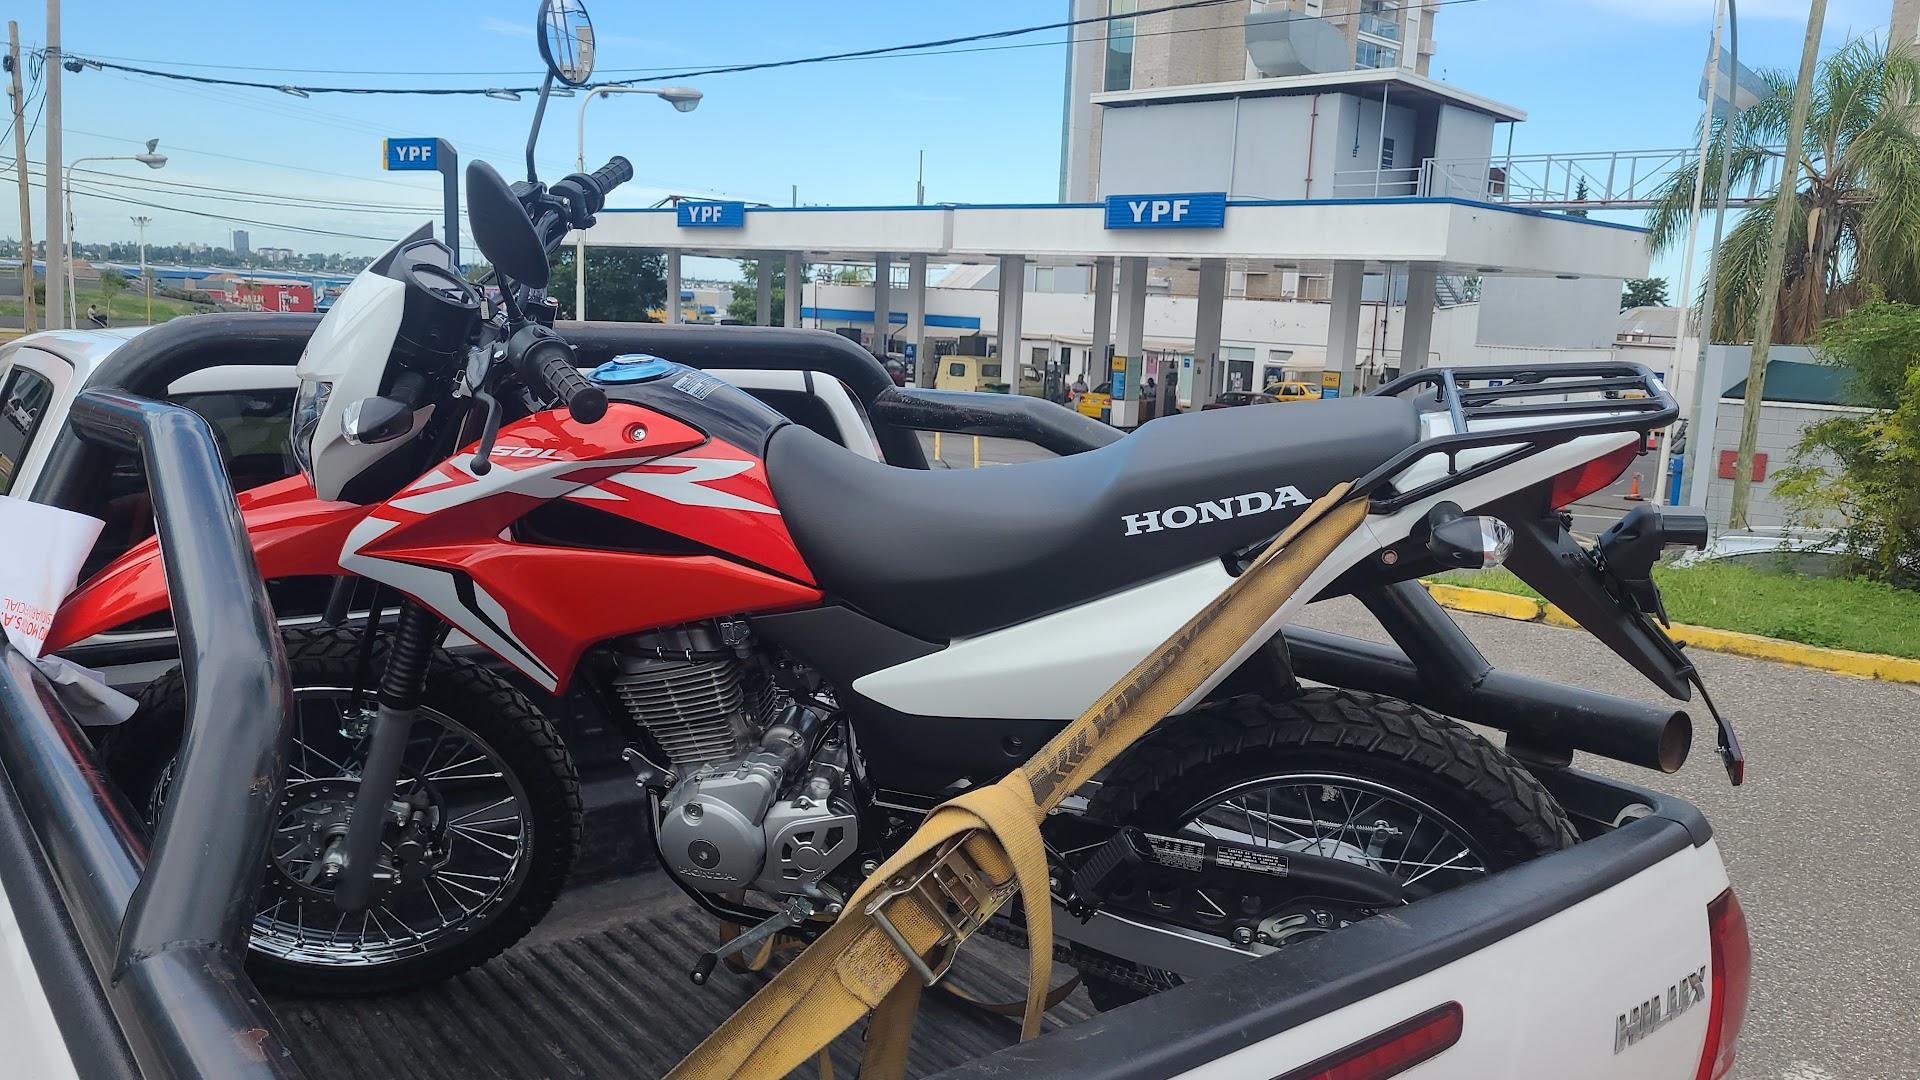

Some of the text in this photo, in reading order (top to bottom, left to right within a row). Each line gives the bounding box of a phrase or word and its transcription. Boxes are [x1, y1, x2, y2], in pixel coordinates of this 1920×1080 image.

[396, 145, 431, 161] YPF
[688, 206, 722, 222] YPF
[1128, 199, 1190, 222] YPF
[1121, 485, 1313, 537] HONDA
[1614, 964, 1706, 1056] HILUX
